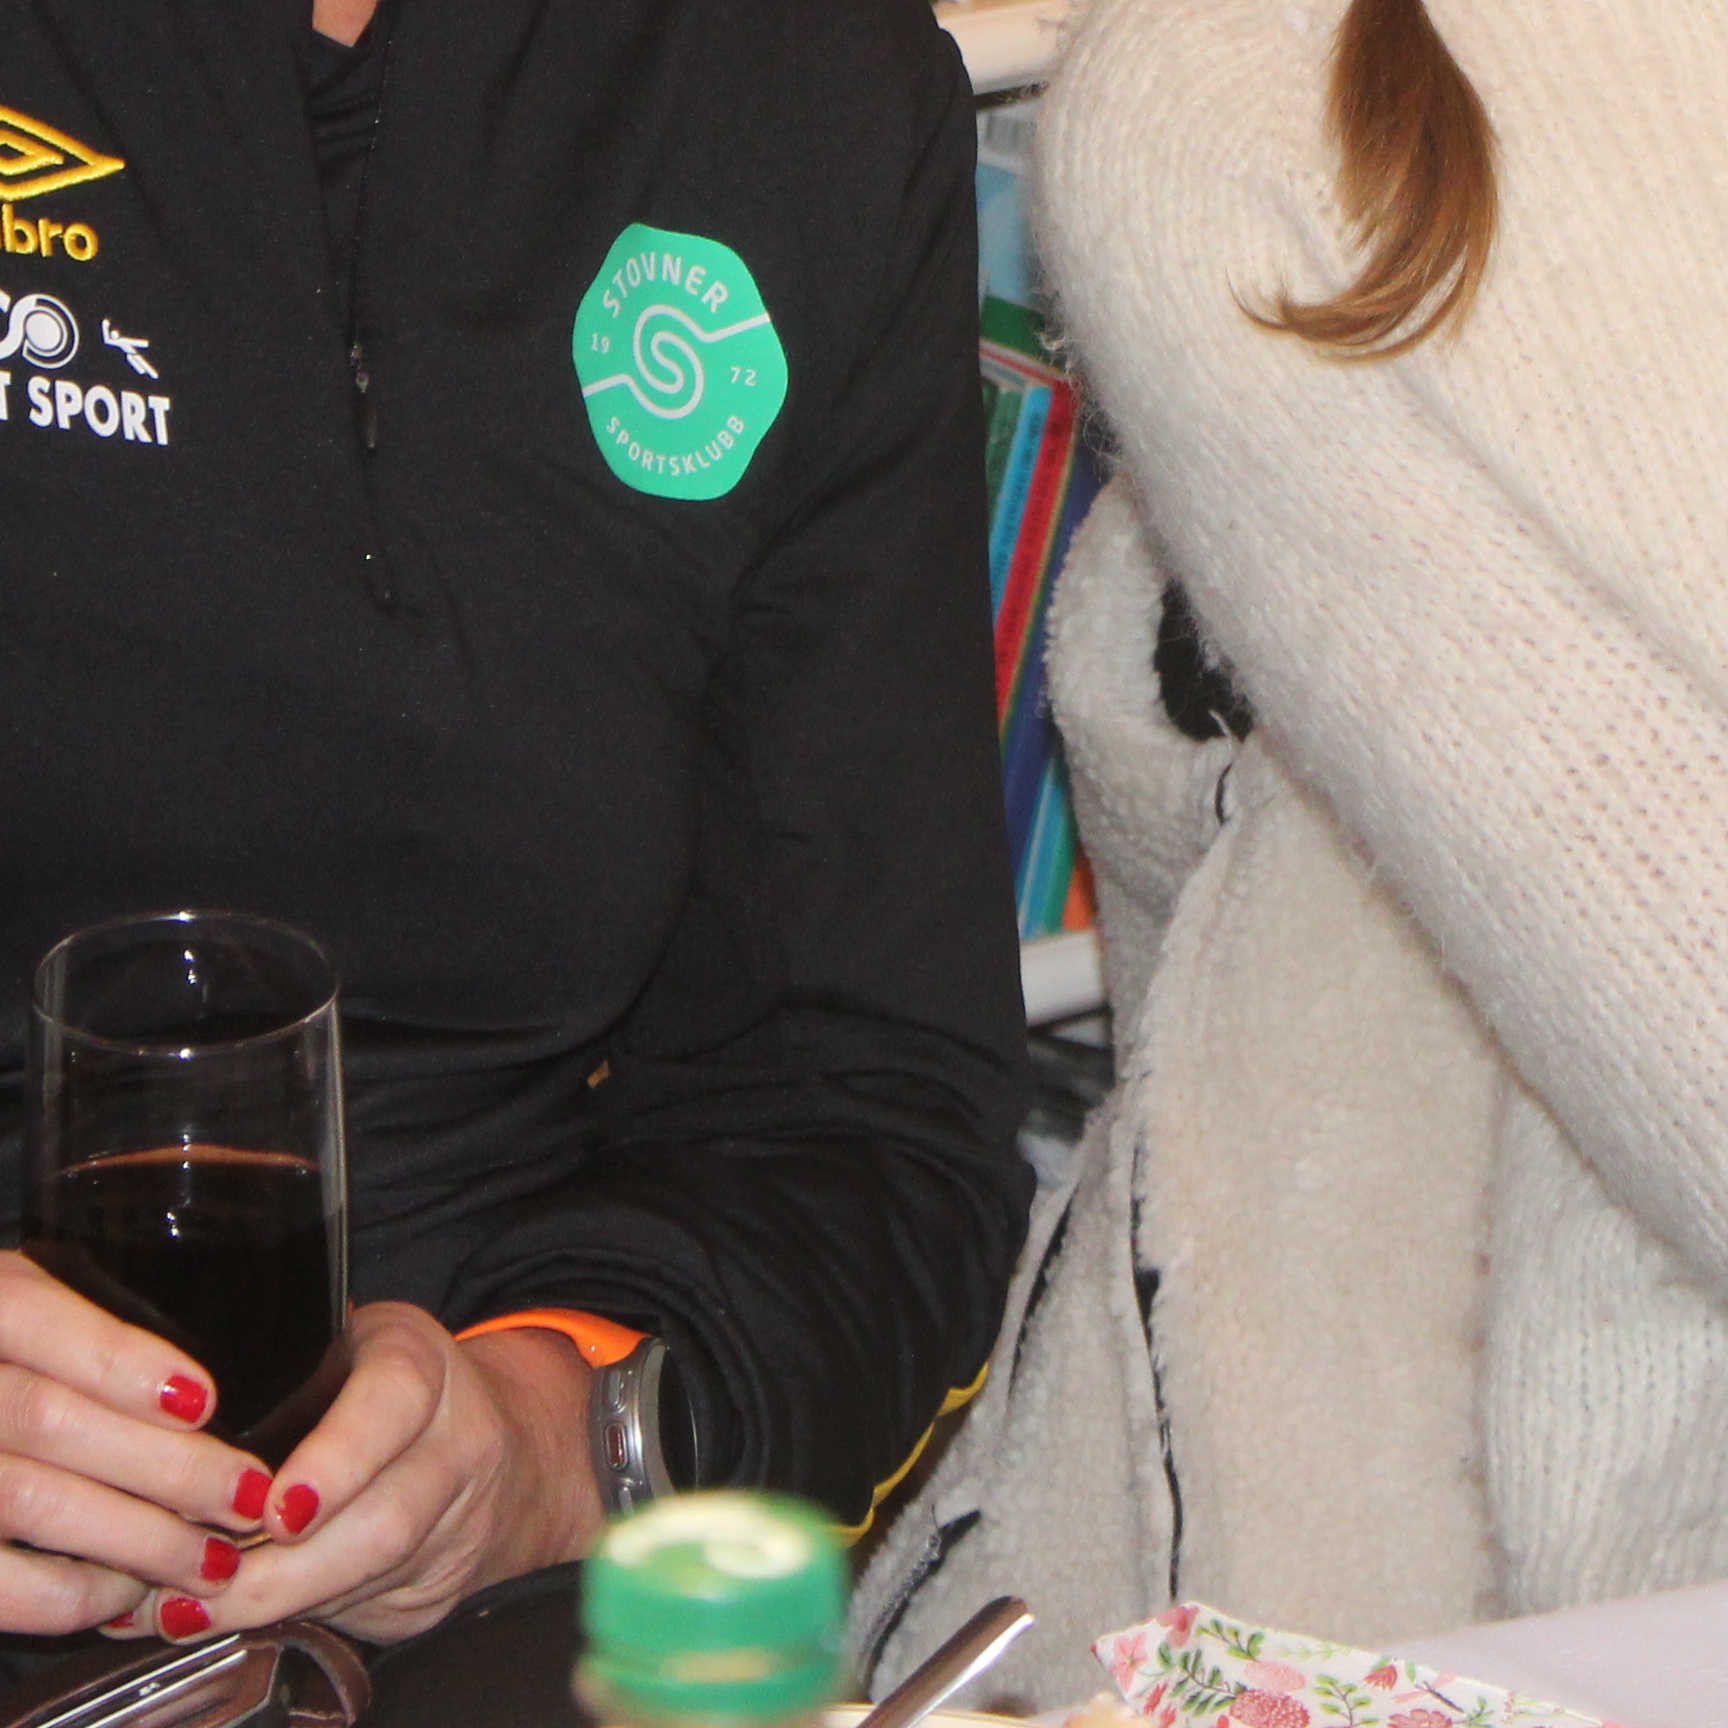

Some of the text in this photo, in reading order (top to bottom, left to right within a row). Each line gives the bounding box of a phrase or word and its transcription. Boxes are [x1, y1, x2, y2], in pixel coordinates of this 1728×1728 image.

[600, 249, 731, 315] STOVNER
[588, 330, 613, 356] 19
[26, 373, 171, 447] SPORT
[727, 365, 759, 390] 72
[603, 412, 748, 478] SPORTSKLUBB
